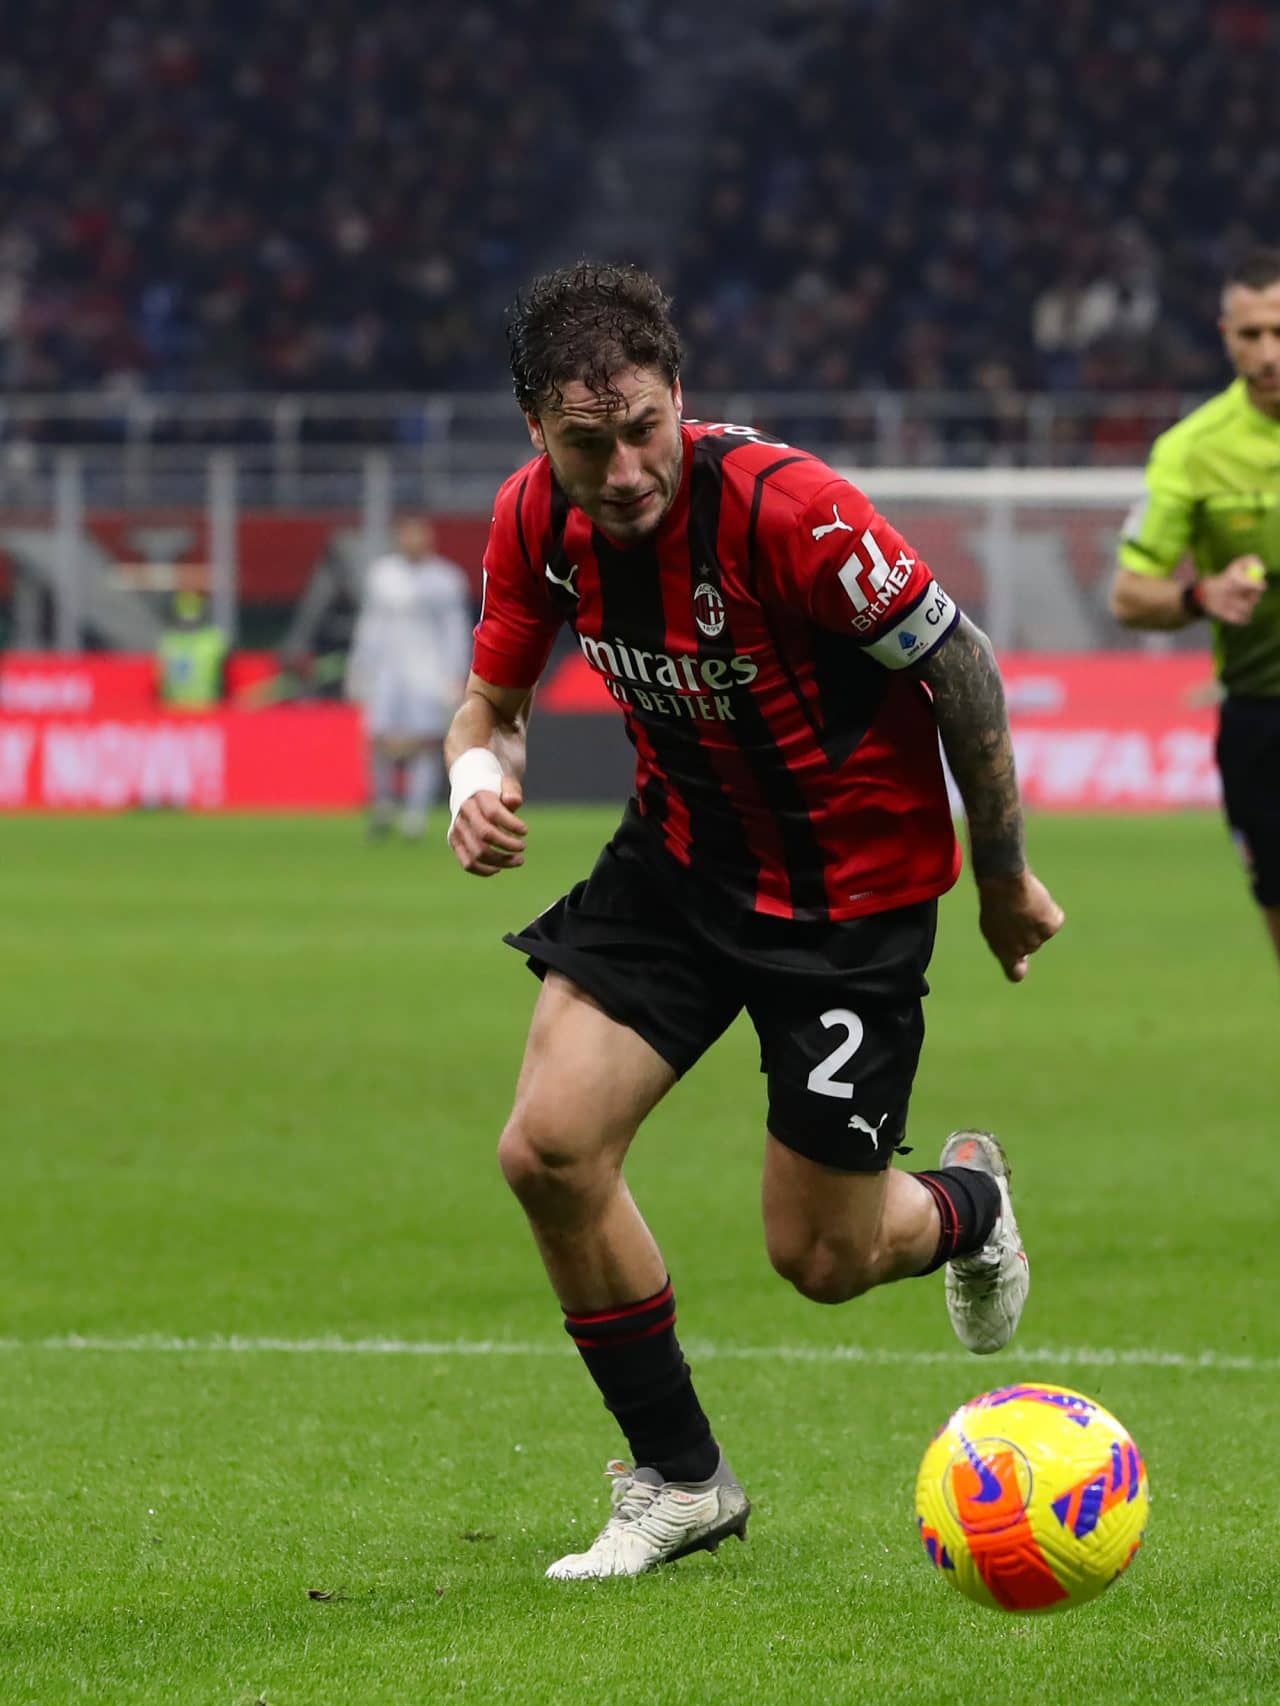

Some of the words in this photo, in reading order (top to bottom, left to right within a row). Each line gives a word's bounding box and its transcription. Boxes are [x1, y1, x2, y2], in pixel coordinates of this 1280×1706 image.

[851, 550, 916, 632] BitMEX
[578, 631, 759, 692] mirates
[633, 687, 737, 721] BETTER
[806, 1008, 864, 1099] 2
